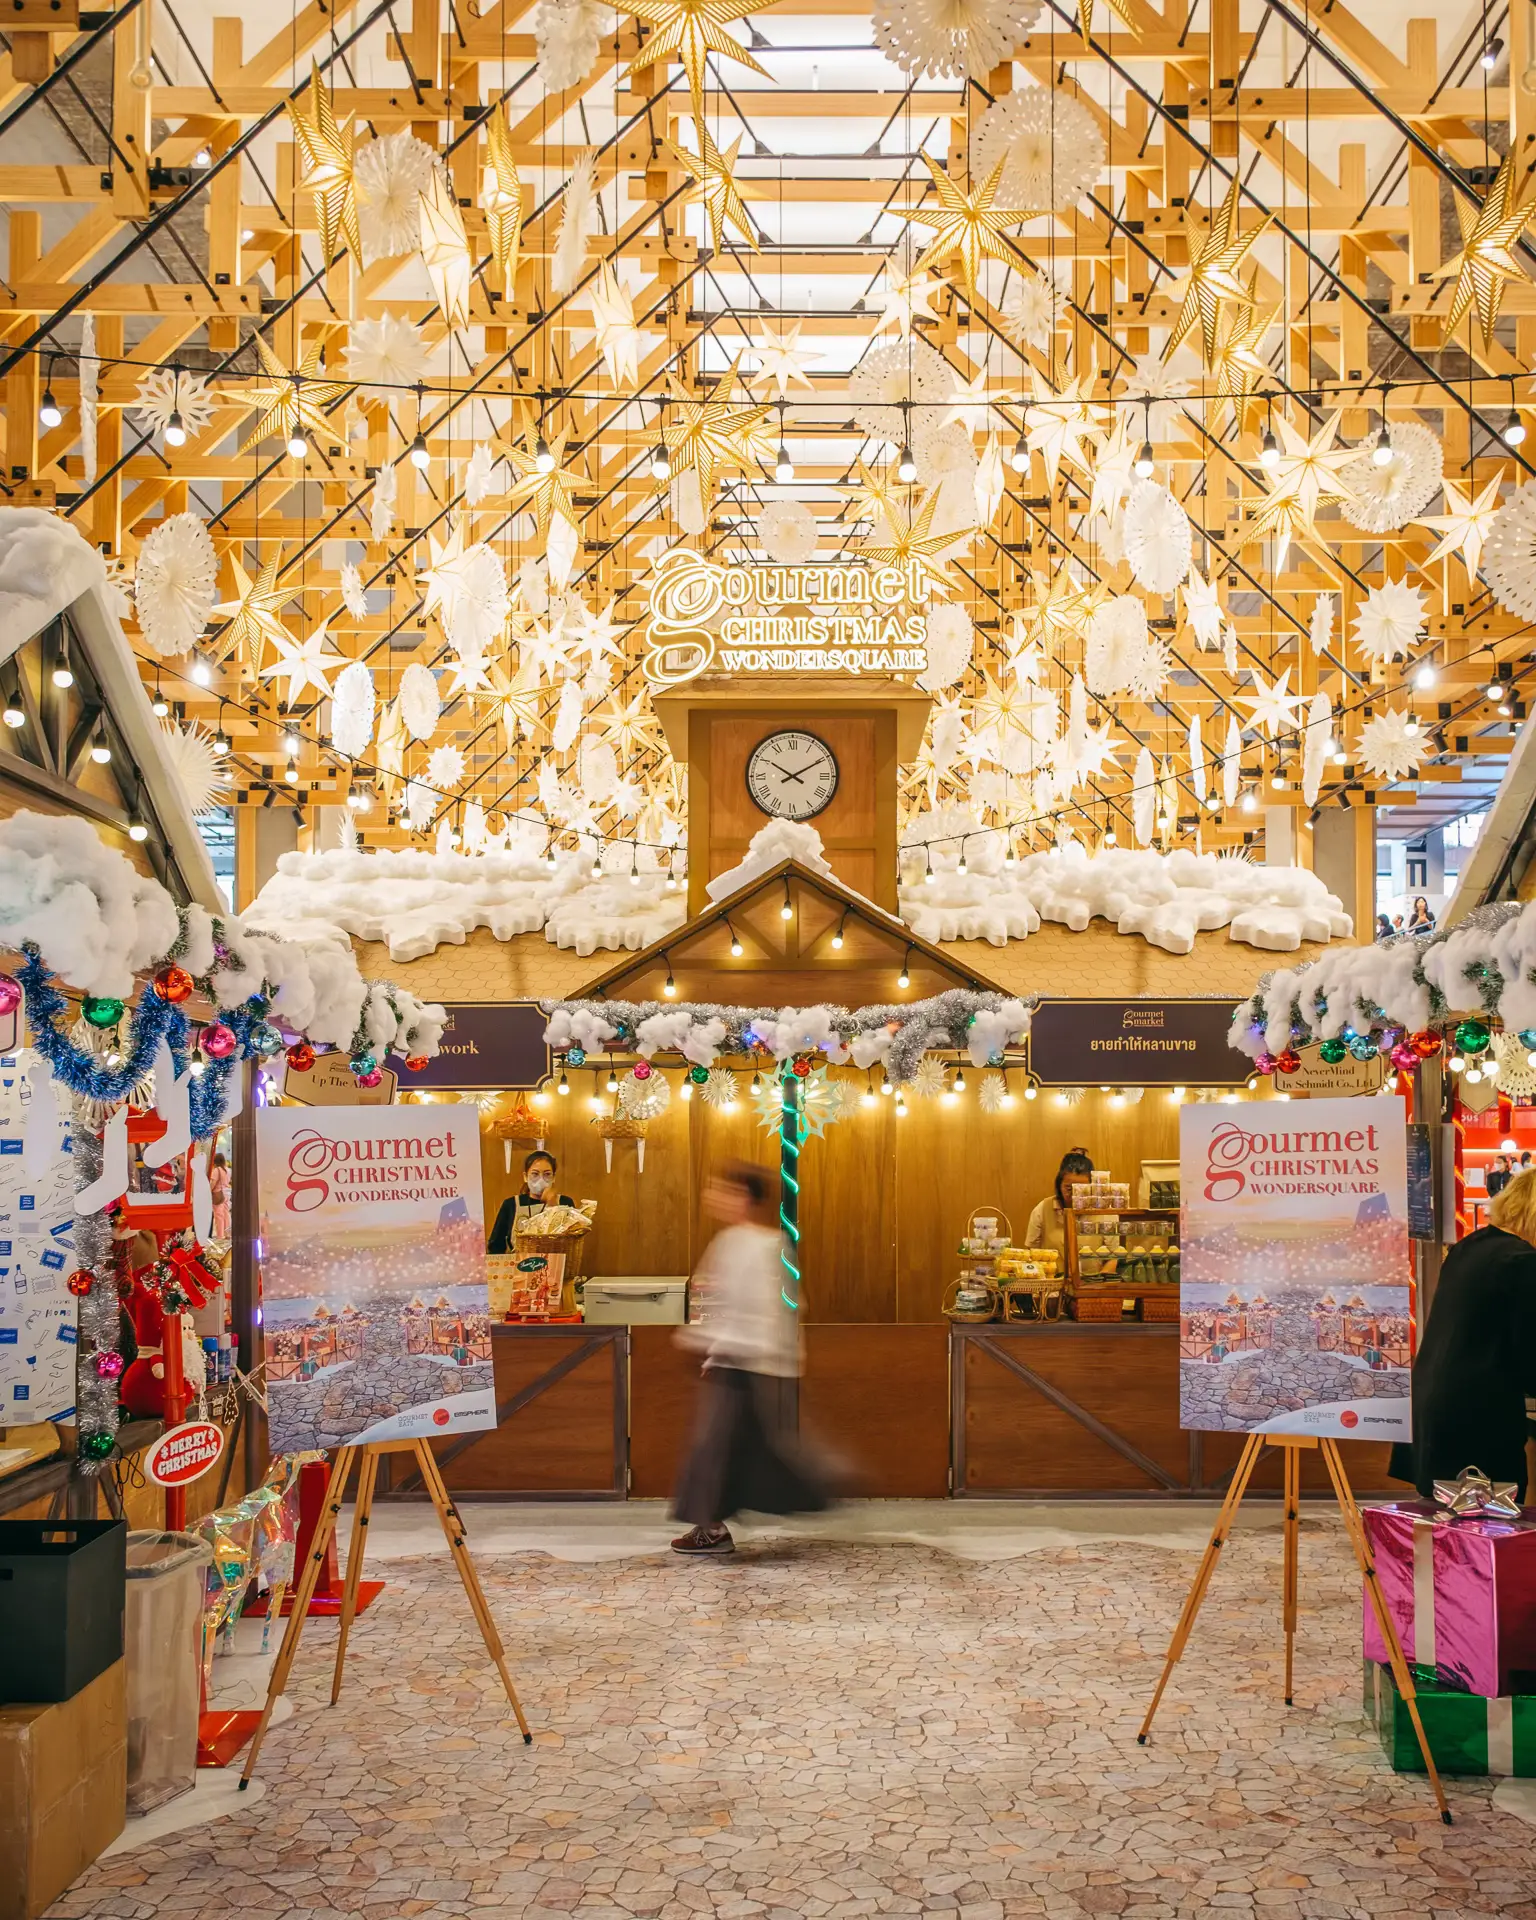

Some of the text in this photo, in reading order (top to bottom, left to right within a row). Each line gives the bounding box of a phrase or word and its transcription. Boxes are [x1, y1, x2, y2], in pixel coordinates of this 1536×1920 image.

[719, 615, 928, 646] CHRISTMAS
[719, 649, 929, 675] WONDERSQUARE
[788, 740, 798, 750] XII
[820, 772, 830, 781] III
[1133, 1017, 1165, 1025] market
[1302, 1066, 1355, 1076] NeverMind
[312, 1074, 327, 1088] Up
[328, 1076, 349, 1087] The
[1282, 1080, 1293, 1089] by
[1295, 1079, 1334, 1089] Schmidt
[333, 1164, 458, 1185] CHRISTMAS
[1249, 1158, 1379, 1177] CHRISTMAS
[334, 1186, 460, 1204] WONDERSQUARE
[1250, 1181, 1380, 1197] WONDERSQUARE
[169, 1430, 208, 1456] MERRY
[157, 1441, 218, 1476] CHRISTMAS
